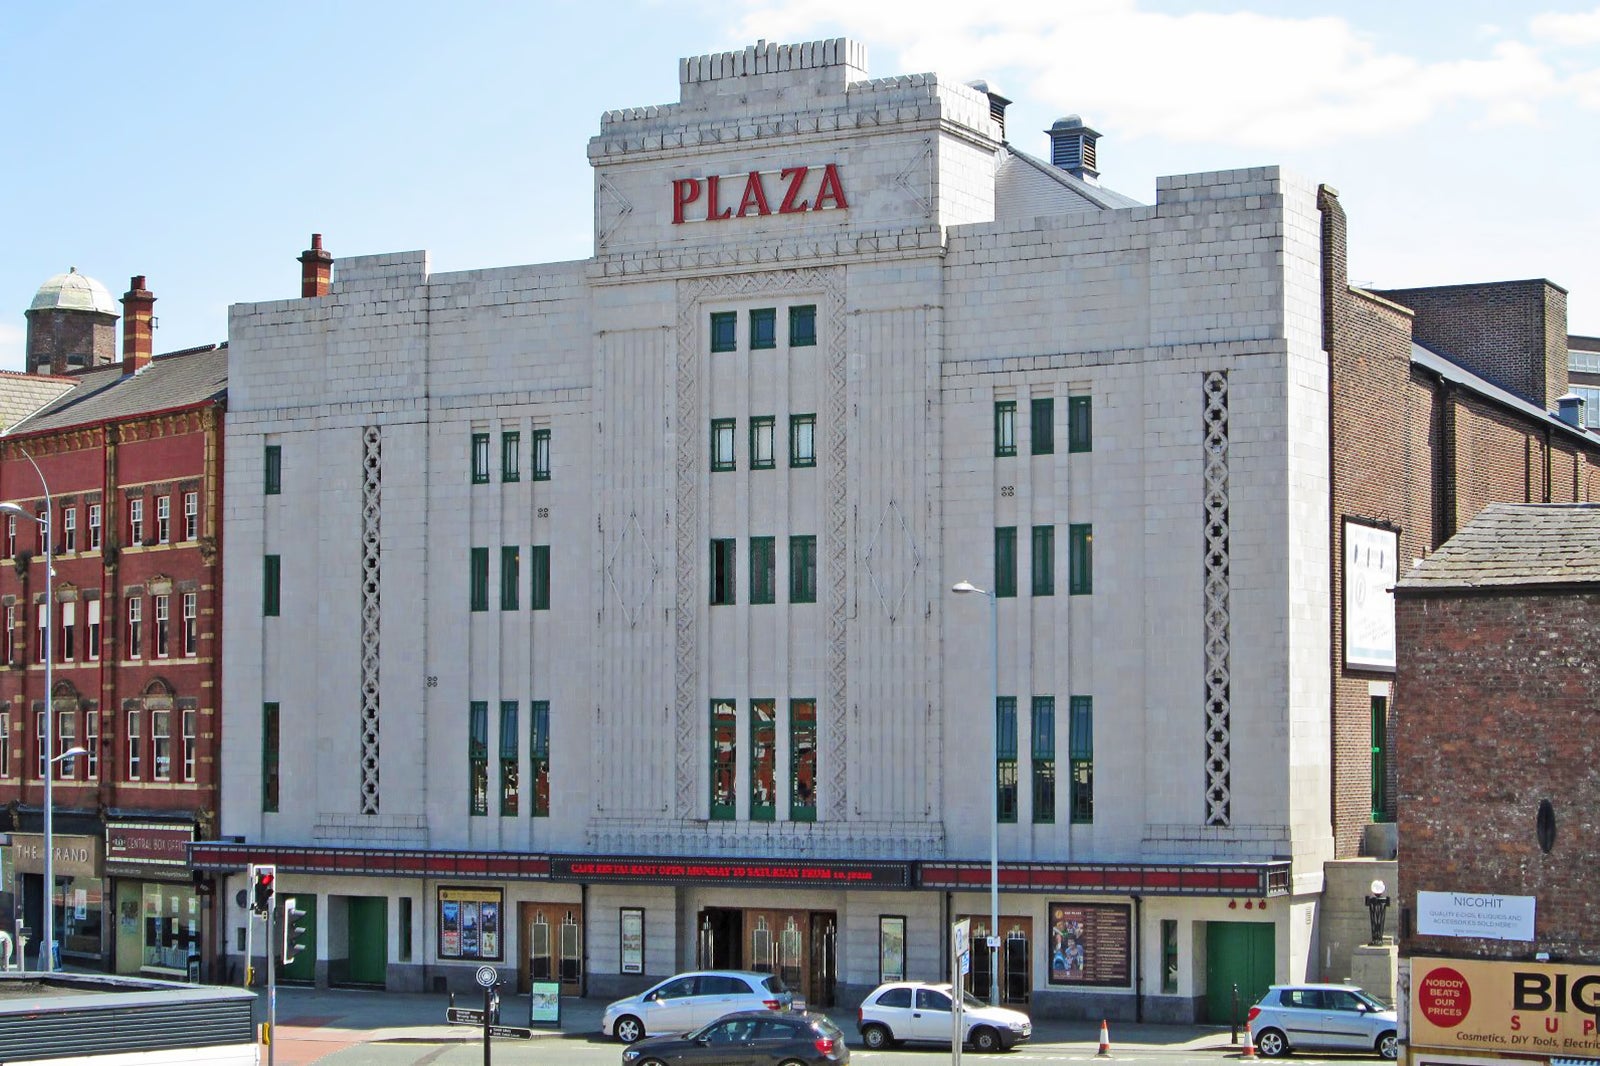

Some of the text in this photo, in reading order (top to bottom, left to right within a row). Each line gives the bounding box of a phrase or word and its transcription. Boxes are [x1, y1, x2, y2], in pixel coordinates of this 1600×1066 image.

[672, 163, 849, 224] PLAZA
[167, 839, 187, 852] OFFIC
[17, 844, 88, 862] THE RAND
[659, 865, 685, 876] OPEN
[687, 866, 731, 877] MONDAY
[733, 867, 745, 877] TO
[747, 867, 799, 878] SATURDAY
[1453, 896, 1504, 908] NICOHIT
[1425, 979, 1464, 989] NOBODY
[1430, 988, 1460, 998] BEATS
[1512, 972, 1600, 1015] BIG
[1434, 998, 1455, 1007] OUR
[1428, 1007, 1462, 1017] PRICES
[1456, 1031, 1507, 1044] Cosmetics,
[1511, 1036, 1529, 1045] DIY
[1532, 1037, 1560, 1048] Tools,
